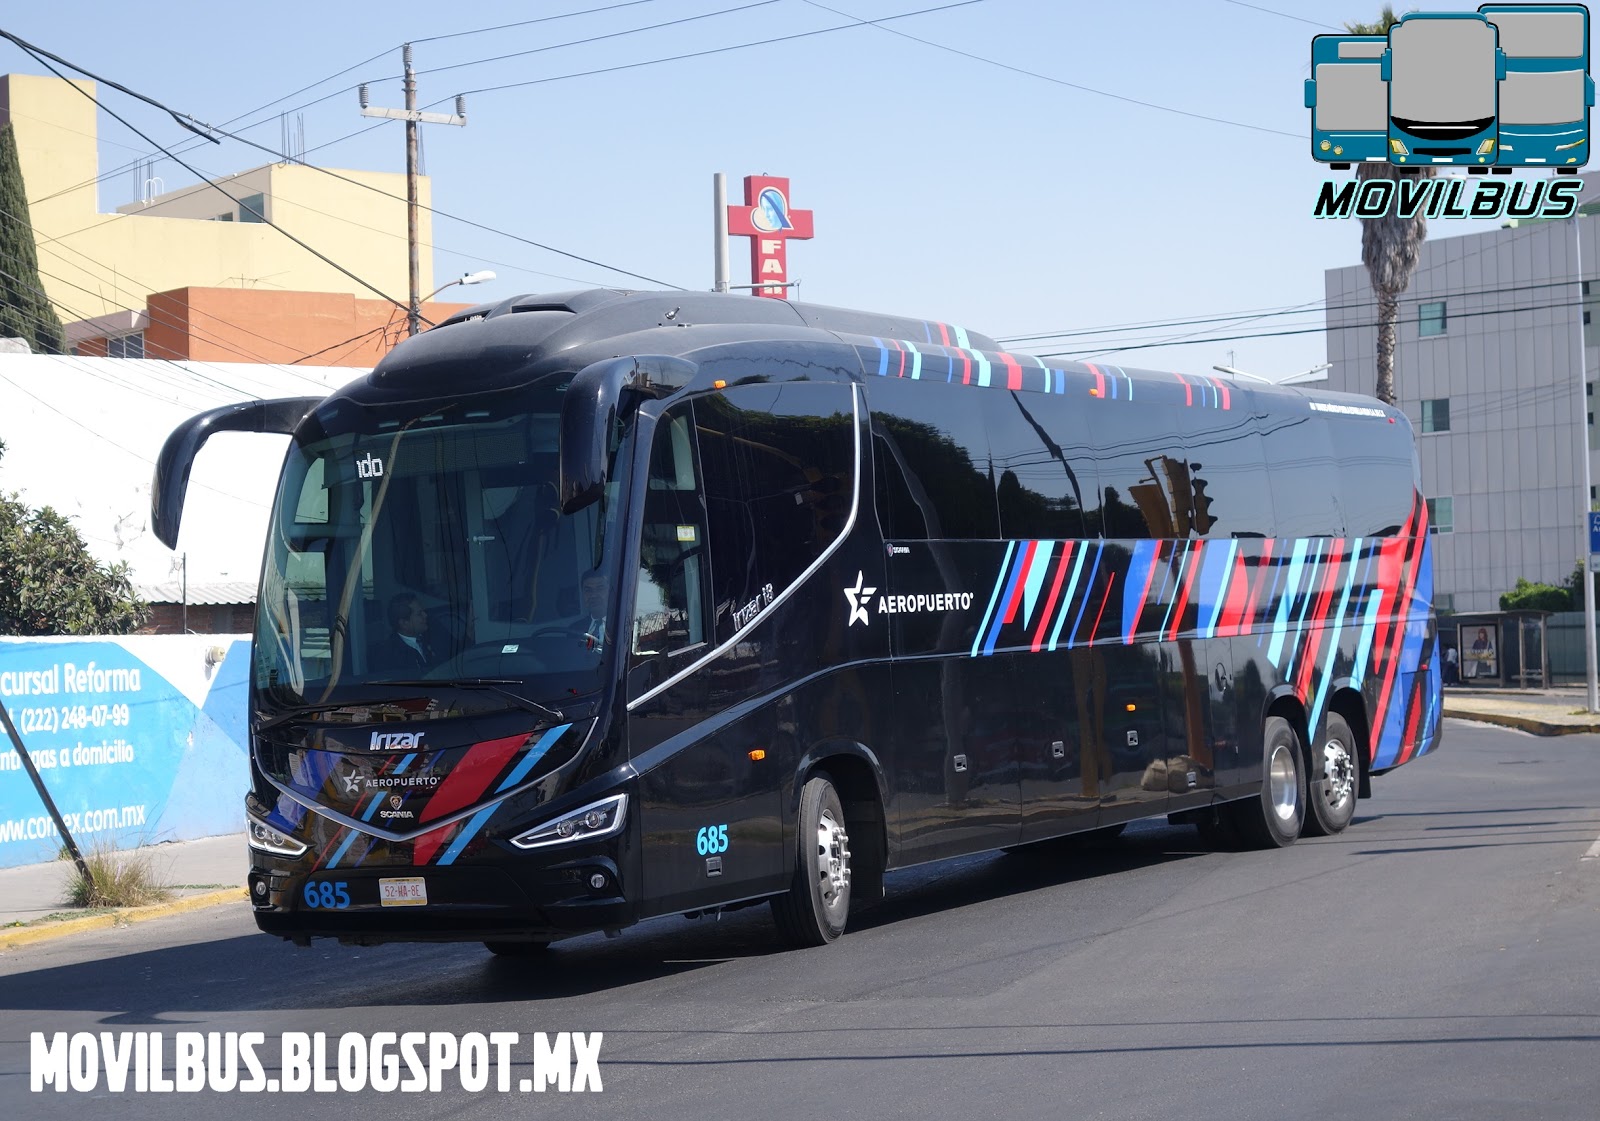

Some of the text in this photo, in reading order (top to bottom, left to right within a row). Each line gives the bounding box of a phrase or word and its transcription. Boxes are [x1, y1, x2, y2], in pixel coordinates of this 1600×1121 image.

[878, 592, 971, 613] AEROPUERTO
[0, 661, 141, 696] cursal Reforma
[21, 706, 58, 735] (222)
[61, 704, 130, 729] 248-07-99
[60, 748, 70, 767] a
[72, 739, 134, 767] domicilio
[369, 731, 425, 751] Irizar
[365, 777, 438, 788] AEROPUERTO
[380, 810, 414, 818] SCANIA
[697, 824, 729, 855] 685
[304, 881, 350, 909] 685
